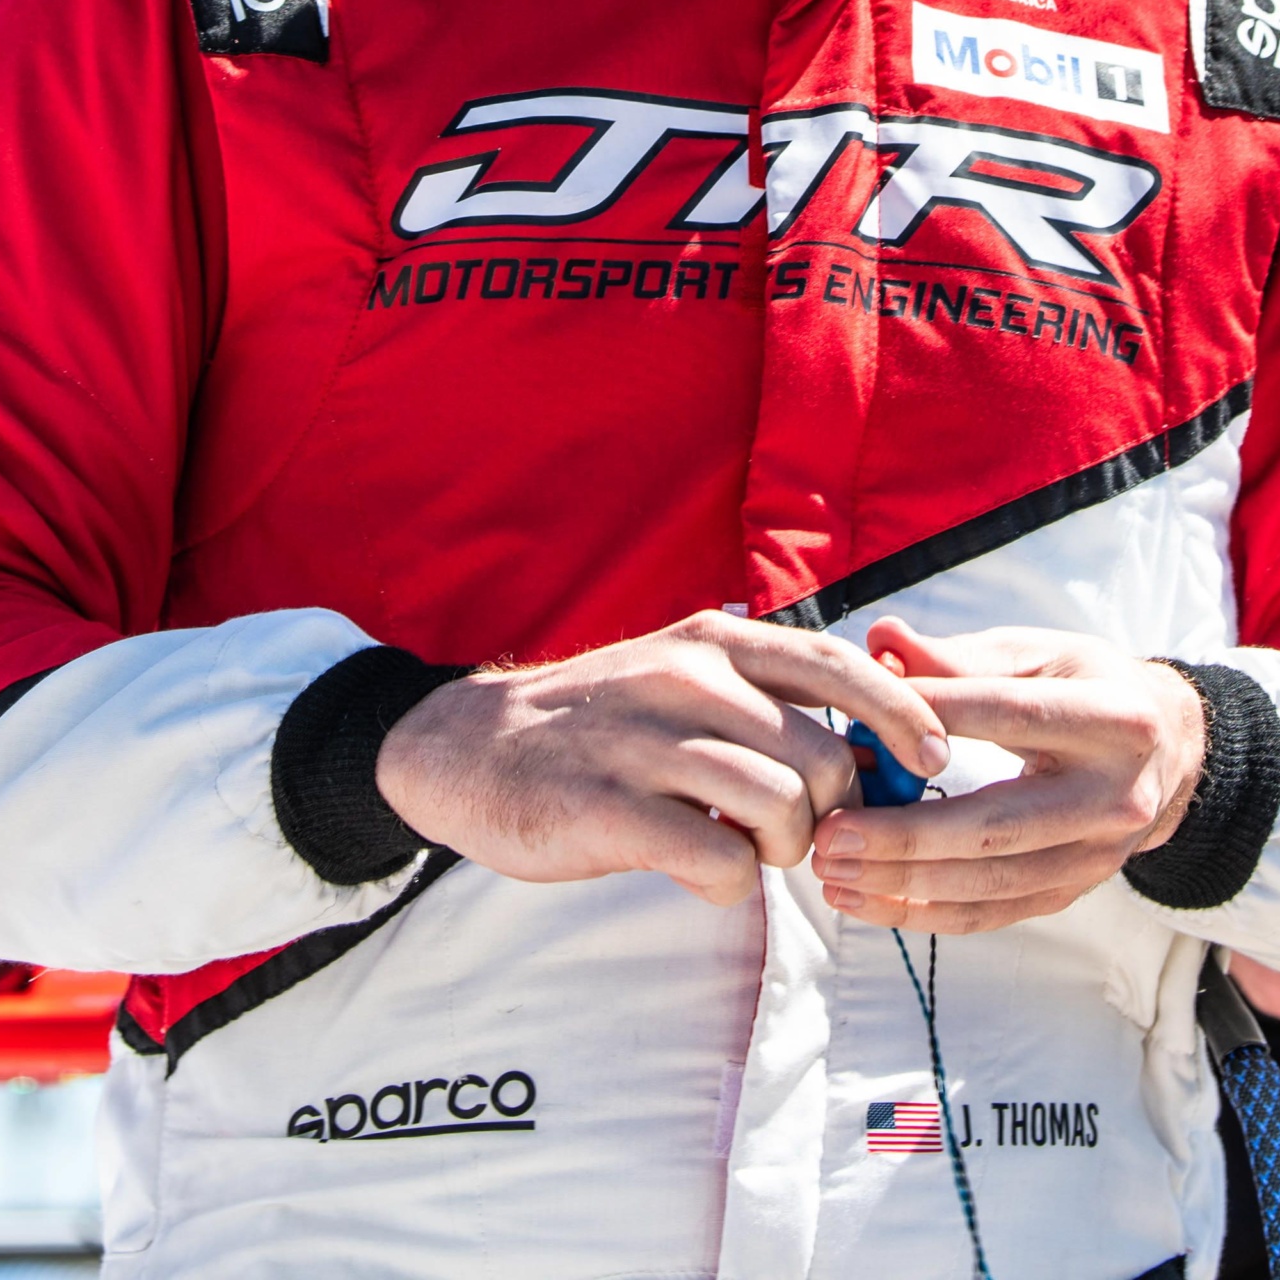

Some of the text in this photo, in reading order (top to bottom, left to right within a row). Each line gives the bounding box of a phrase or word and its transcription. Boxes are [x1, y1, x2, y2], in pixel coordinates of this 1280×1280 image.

[934, 30, 1082, 95] Mobil
[391, 86, 1163, 290] JTR
[822, 263, 1144, 366] ENGINEERING
[287, 1069, 537, 1144] sparco
[960, 1102, 1099, 1148] J. THOMAS
